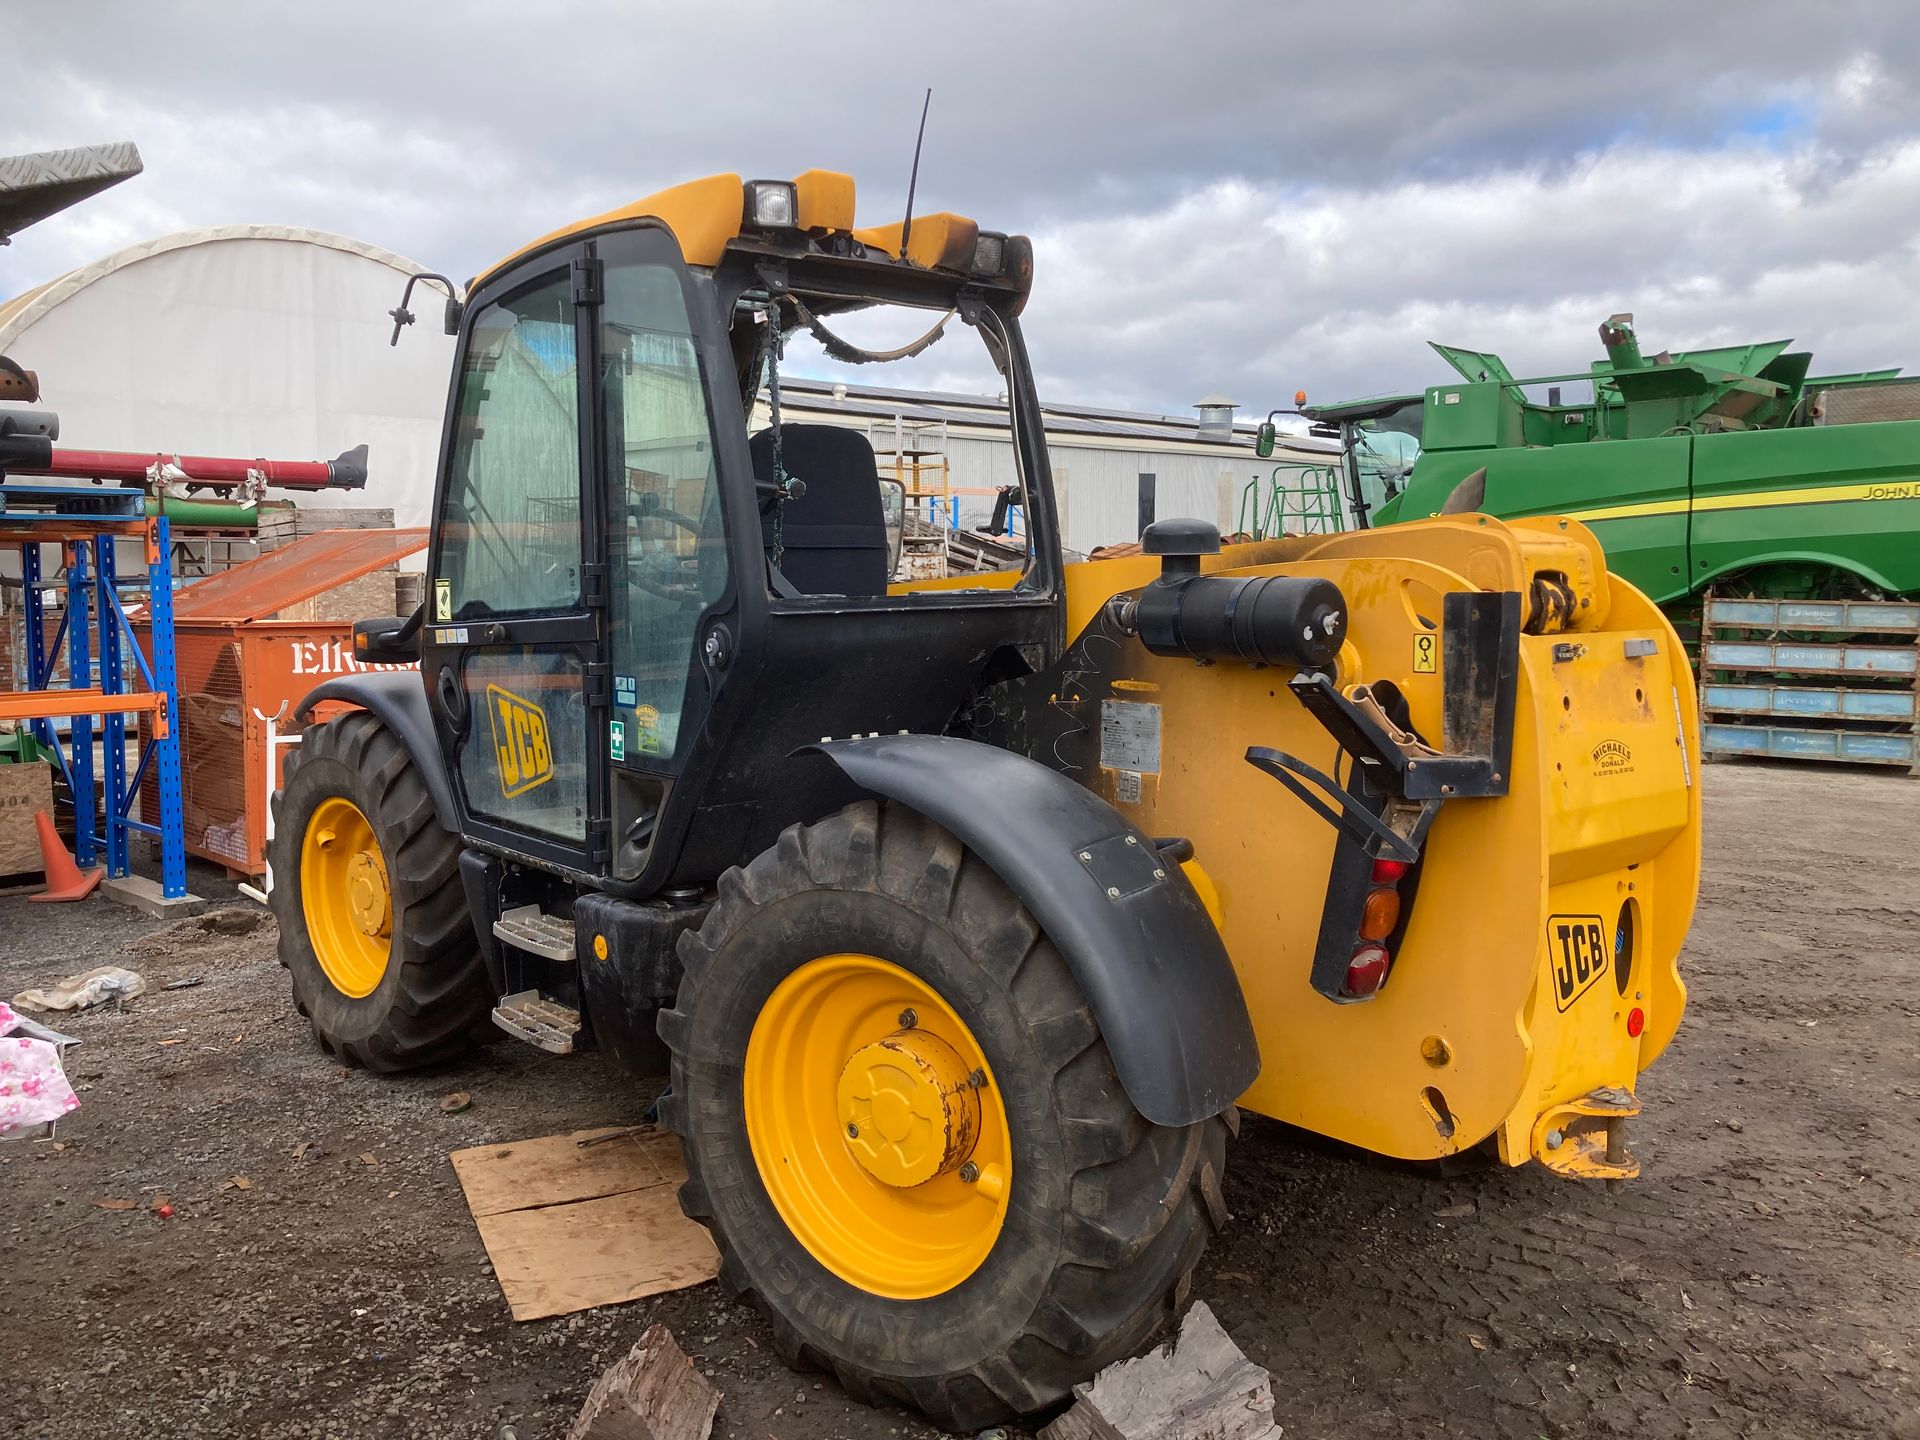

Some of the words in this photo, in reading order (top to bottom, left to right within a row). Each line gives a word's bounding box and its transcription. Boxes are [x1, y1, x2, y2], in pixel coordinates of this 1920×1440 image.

[1432, 390, 1439, 406] 1
[1862, 486, 1910, 499] JOHN
[498, 697, 549, 786] JCB
[1592, 743, 1632, 762] MICHAELS
[1601, 759, 1625, 768] DONALD
[1557, 924, 1603, 1000] JCB
